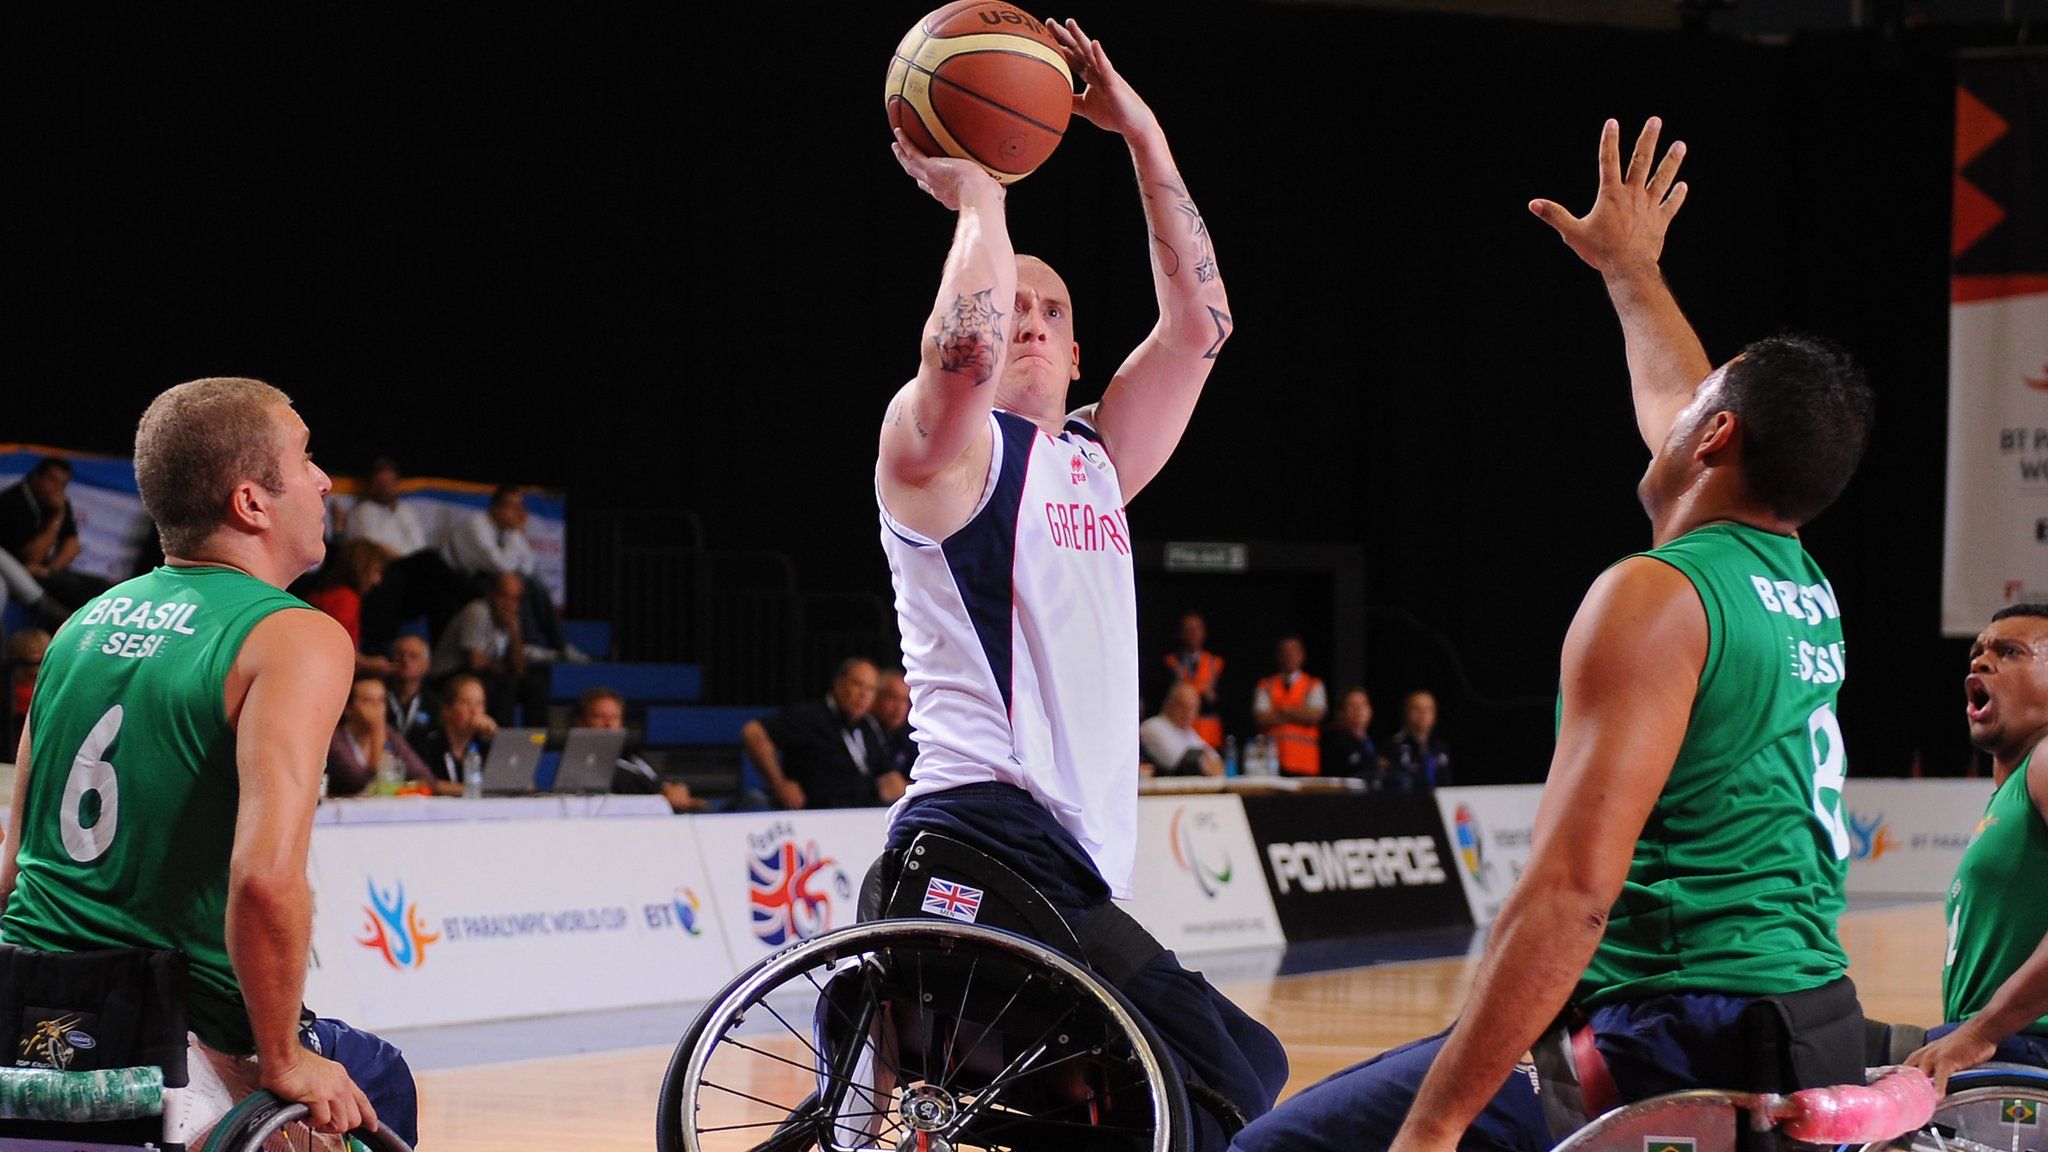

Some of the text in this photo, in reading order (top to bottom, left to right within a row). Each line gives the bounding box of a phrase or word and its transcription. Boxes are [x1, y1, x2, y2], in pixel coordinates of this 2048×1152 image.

[82, 597, 198, 635] BRASIL
[102, 631, 163, 658] SESI
[60, 704, 124, 863] 6
[1267, 835, 1447, 895] POWERADE
[643, 902, 674, 931] BT
